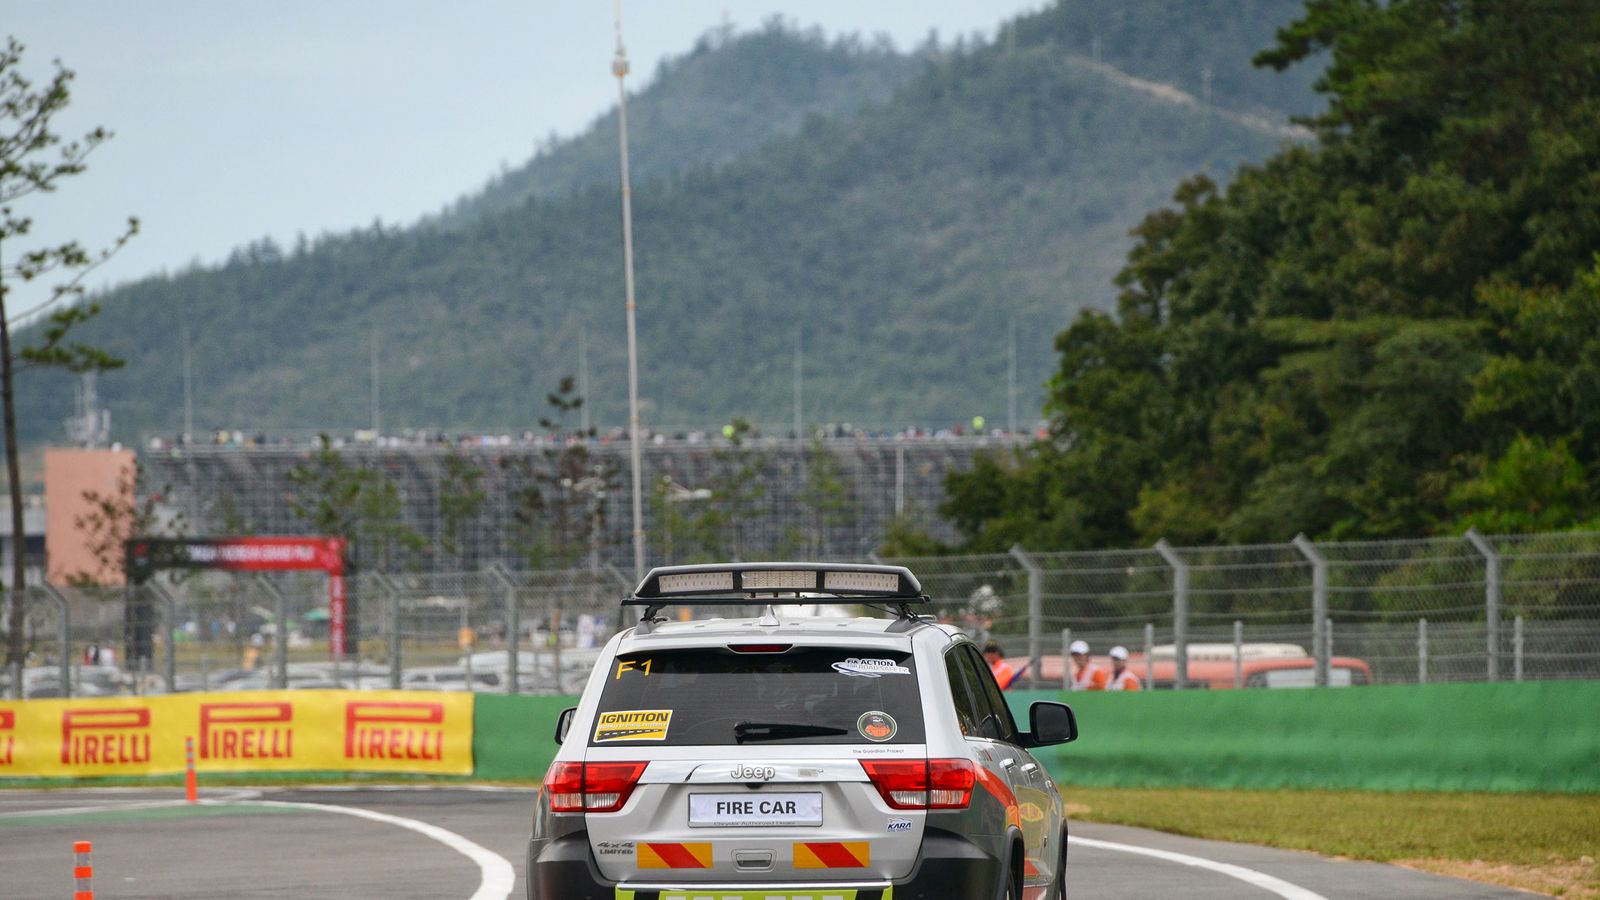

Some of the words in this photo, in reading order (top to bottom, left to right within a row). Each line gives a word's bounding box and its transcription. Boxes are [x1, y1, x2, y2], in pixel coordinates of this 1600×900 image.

[860, 659, 894, 667] ACTION
[601, 712, 669, 724] IGNITION
[62, 708, 151, 765] PIRELLI
[200, 702, 293, 760] PIRELLI
[344, 702, 444, 761] PIRELLI
[730, 763, 775, 781] Jeep
[716, 801, 754, 815] FIRE
[759, 801, 797, 814] CAR
[887, 822, 912, 830] KARA
